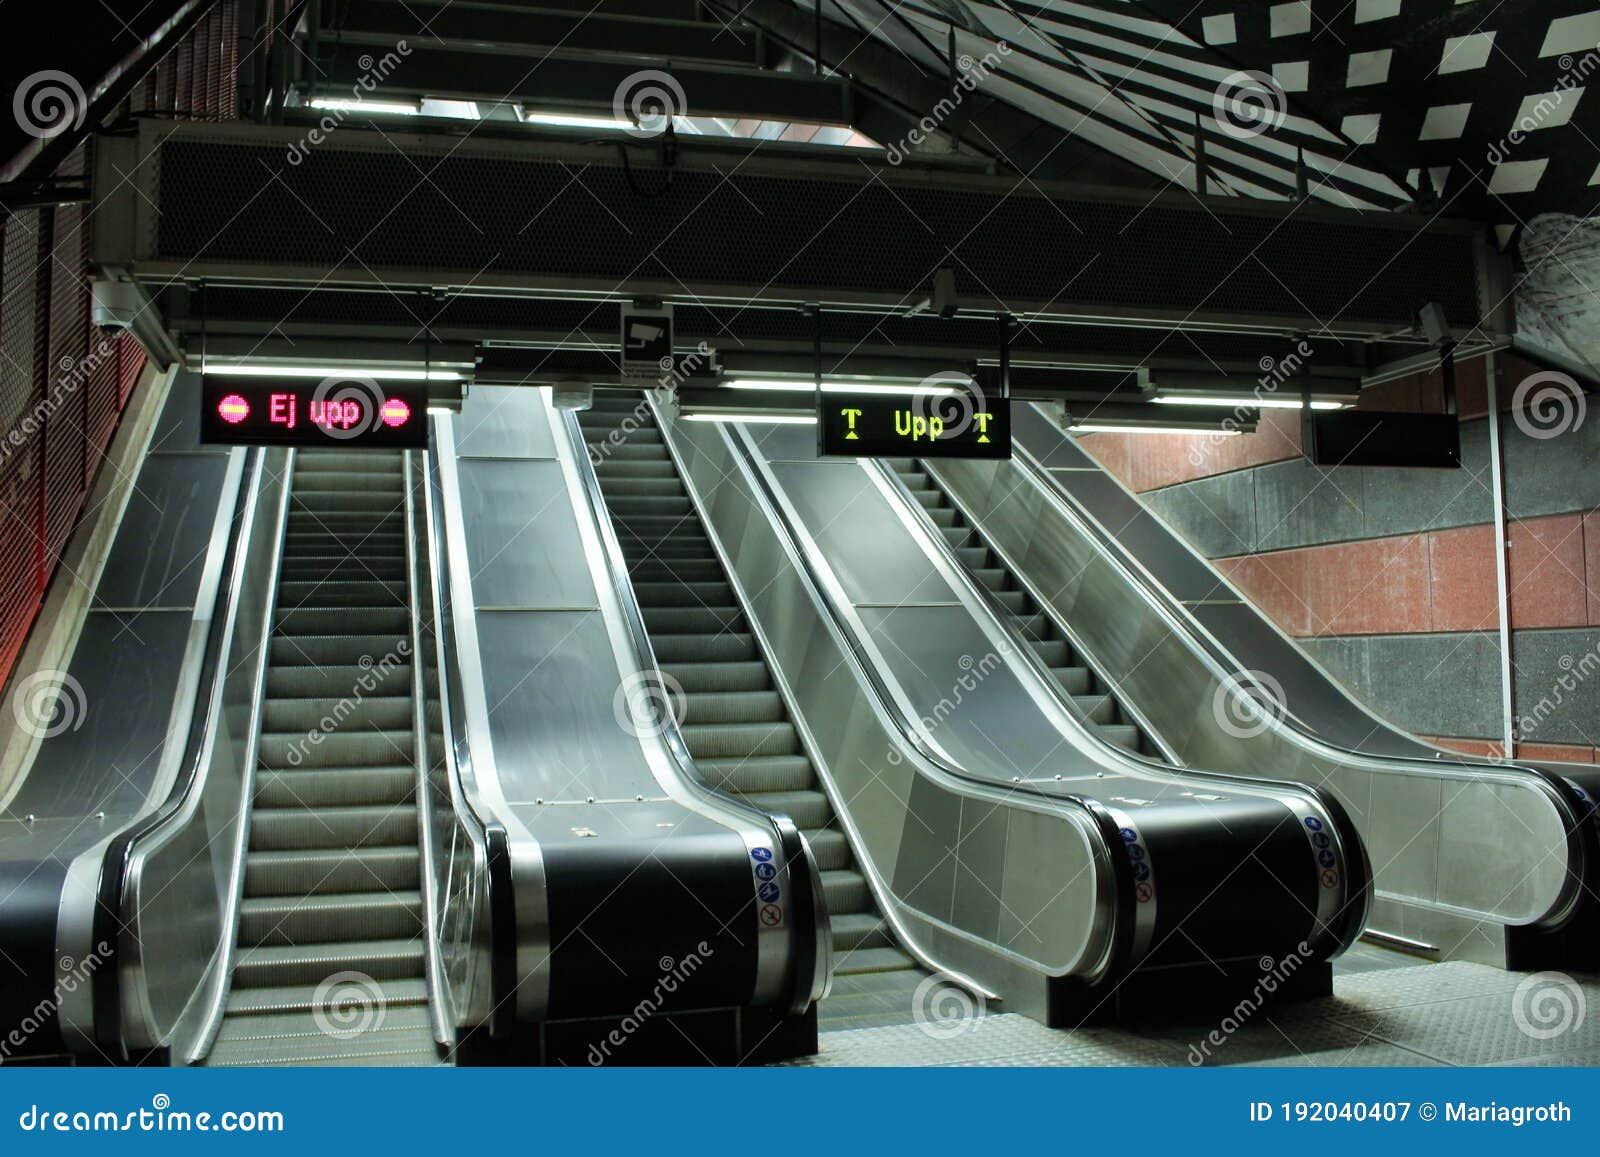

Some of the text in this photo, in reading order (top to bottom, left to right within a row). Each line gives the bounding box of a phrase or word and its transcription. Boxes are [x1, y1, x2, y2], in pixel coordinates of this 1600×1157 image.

[270, 393, 360, 429] Ej upp
[895, 409, 944, 441] Upp
